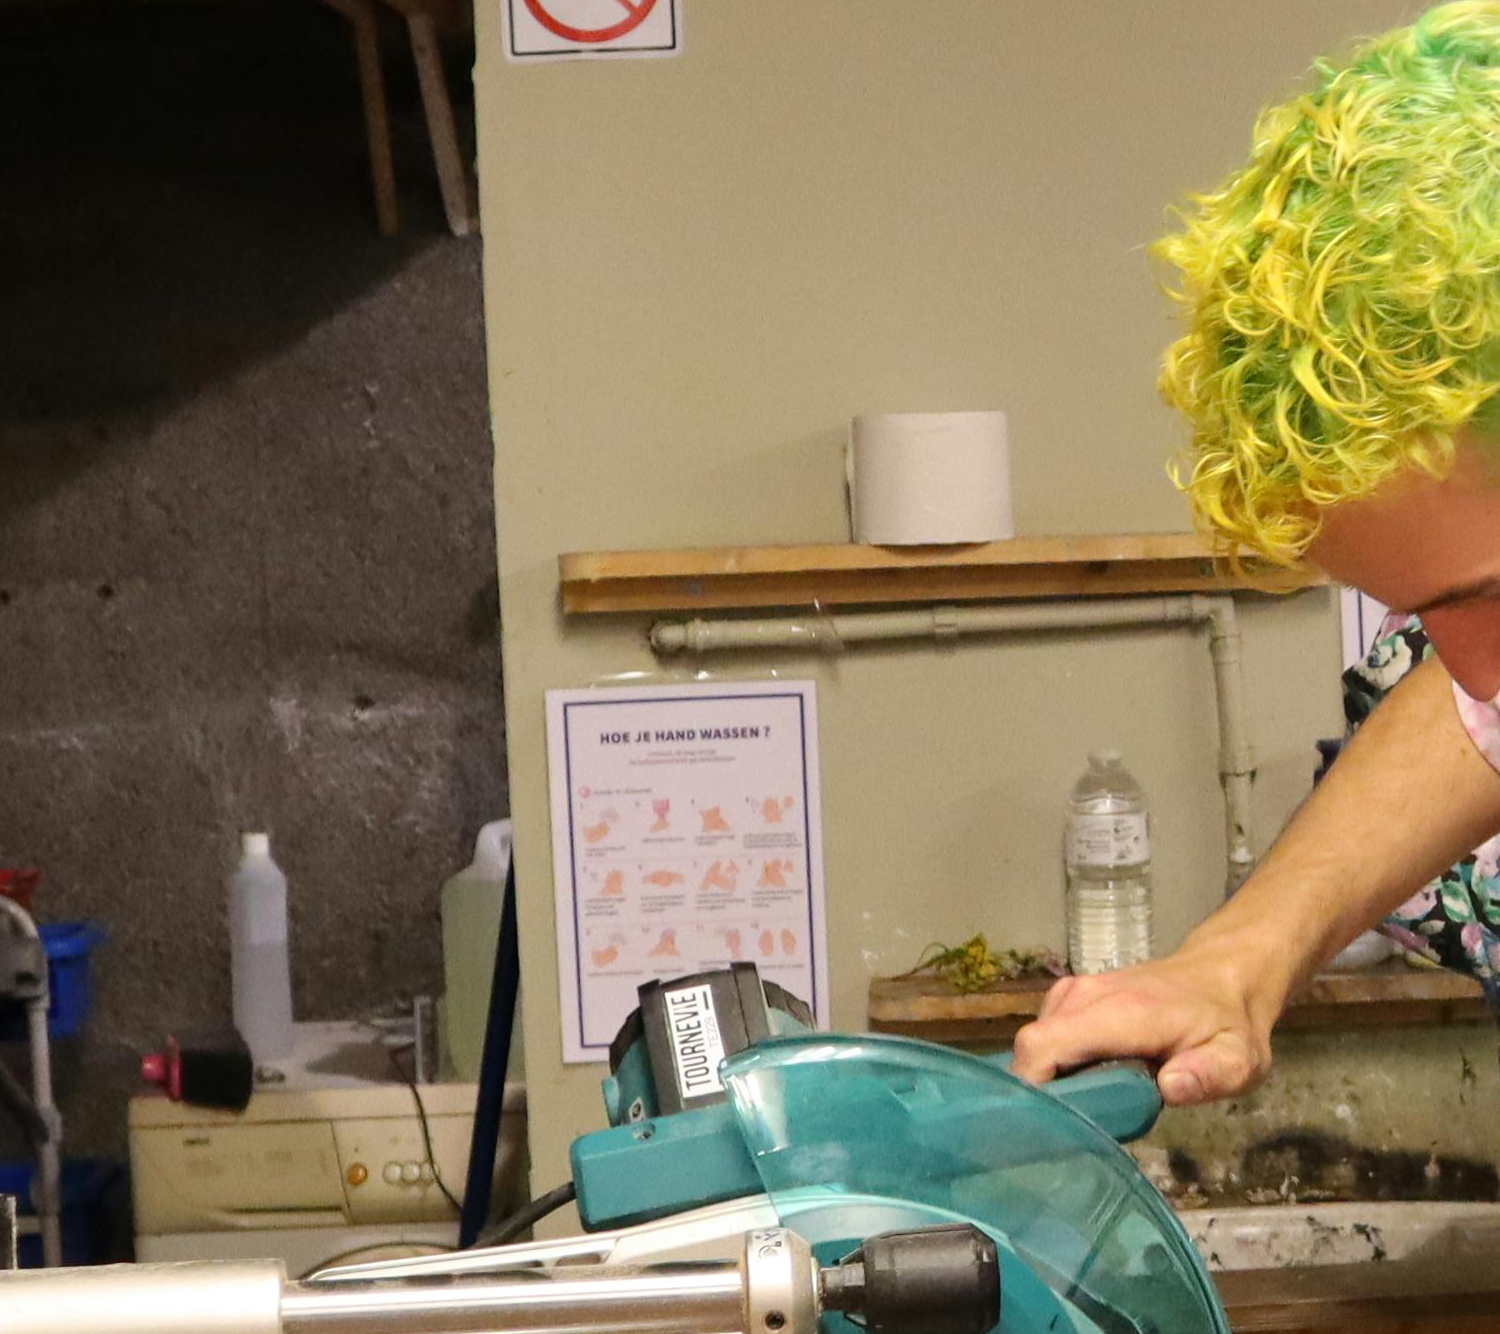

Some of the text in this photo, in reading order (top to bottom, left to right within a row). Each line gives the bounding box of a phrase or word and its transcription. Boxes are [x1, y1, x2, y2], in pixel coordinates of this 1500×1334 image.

[600, 726, 771, 744] HOE JE HAND WASSEN ?
[671, 993, 712, 1091] TOURNEVIE
